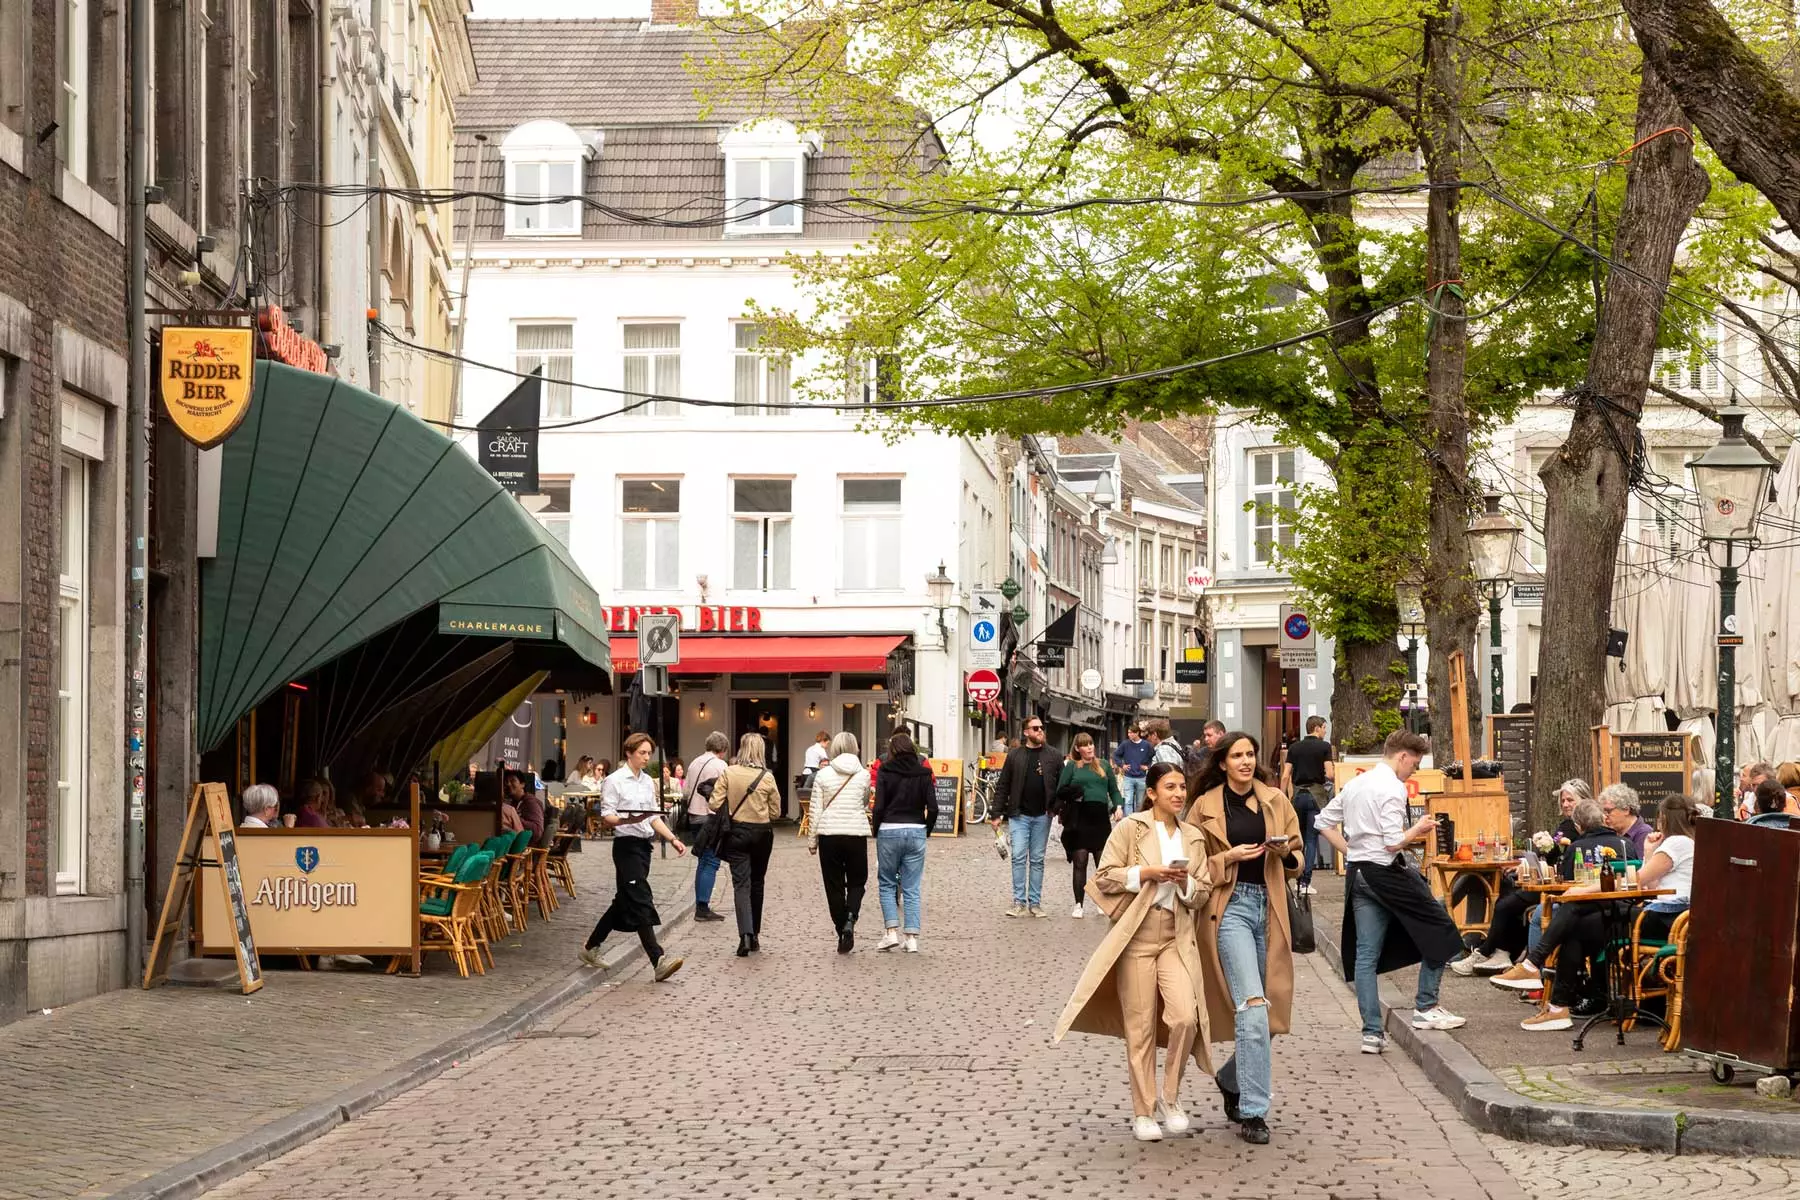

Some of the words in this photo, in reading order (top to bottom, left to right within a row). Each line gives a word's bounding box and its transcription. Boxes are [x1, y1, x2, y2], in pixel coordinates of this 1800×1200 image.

[168, 360, 242, 380] RIDDER
[183, 381, 226, 400] BIER
[187, 409, 222, 417] MAASTRICHT
[497, 435, 521, 443] SALON
[489, 441, 529, 453] CRAFT
[699, 605, 762, 632] BIER
[450, 620, 543, 633] CHARLEMAGNE
[504, 737, 520, 747] HAIR
[503, 748, 518, 758] SKIN
[251, 876, 357, 912] Affligem
